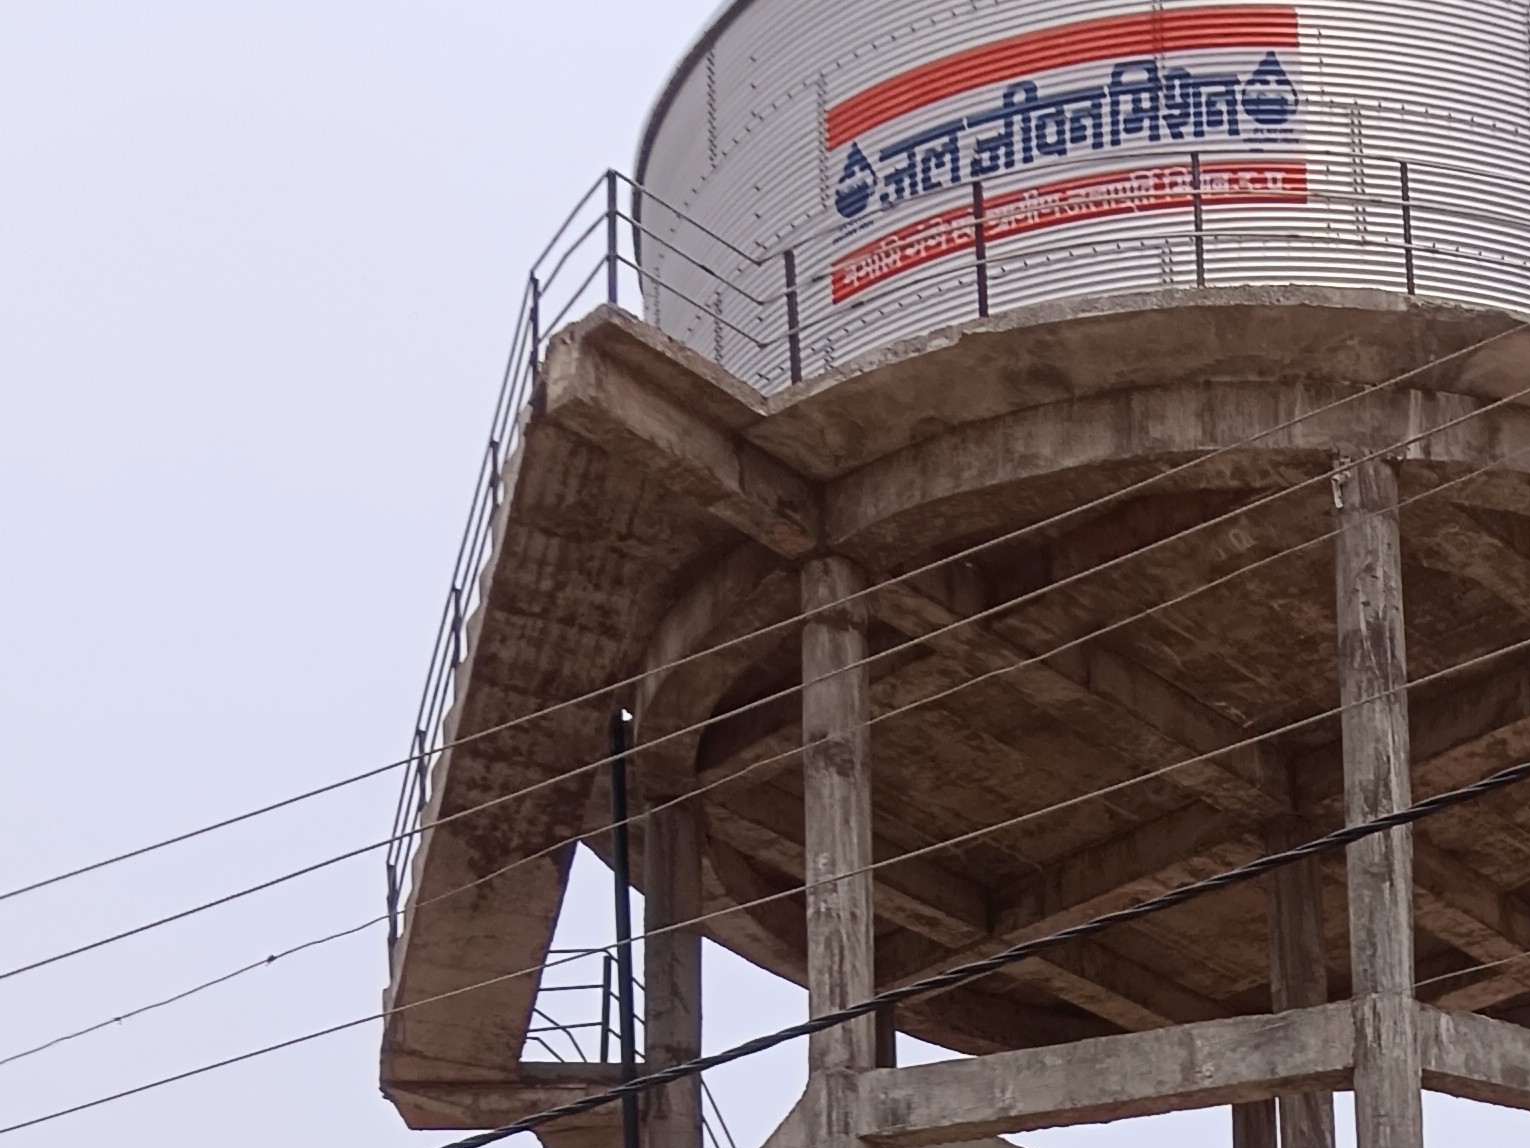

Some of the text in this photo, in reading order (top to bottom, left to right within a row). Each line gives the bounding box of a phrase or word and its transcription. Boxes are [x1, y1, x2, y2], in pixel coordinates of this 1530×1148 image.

[879, 59, 1240, 208] जल जीवन मिशन
